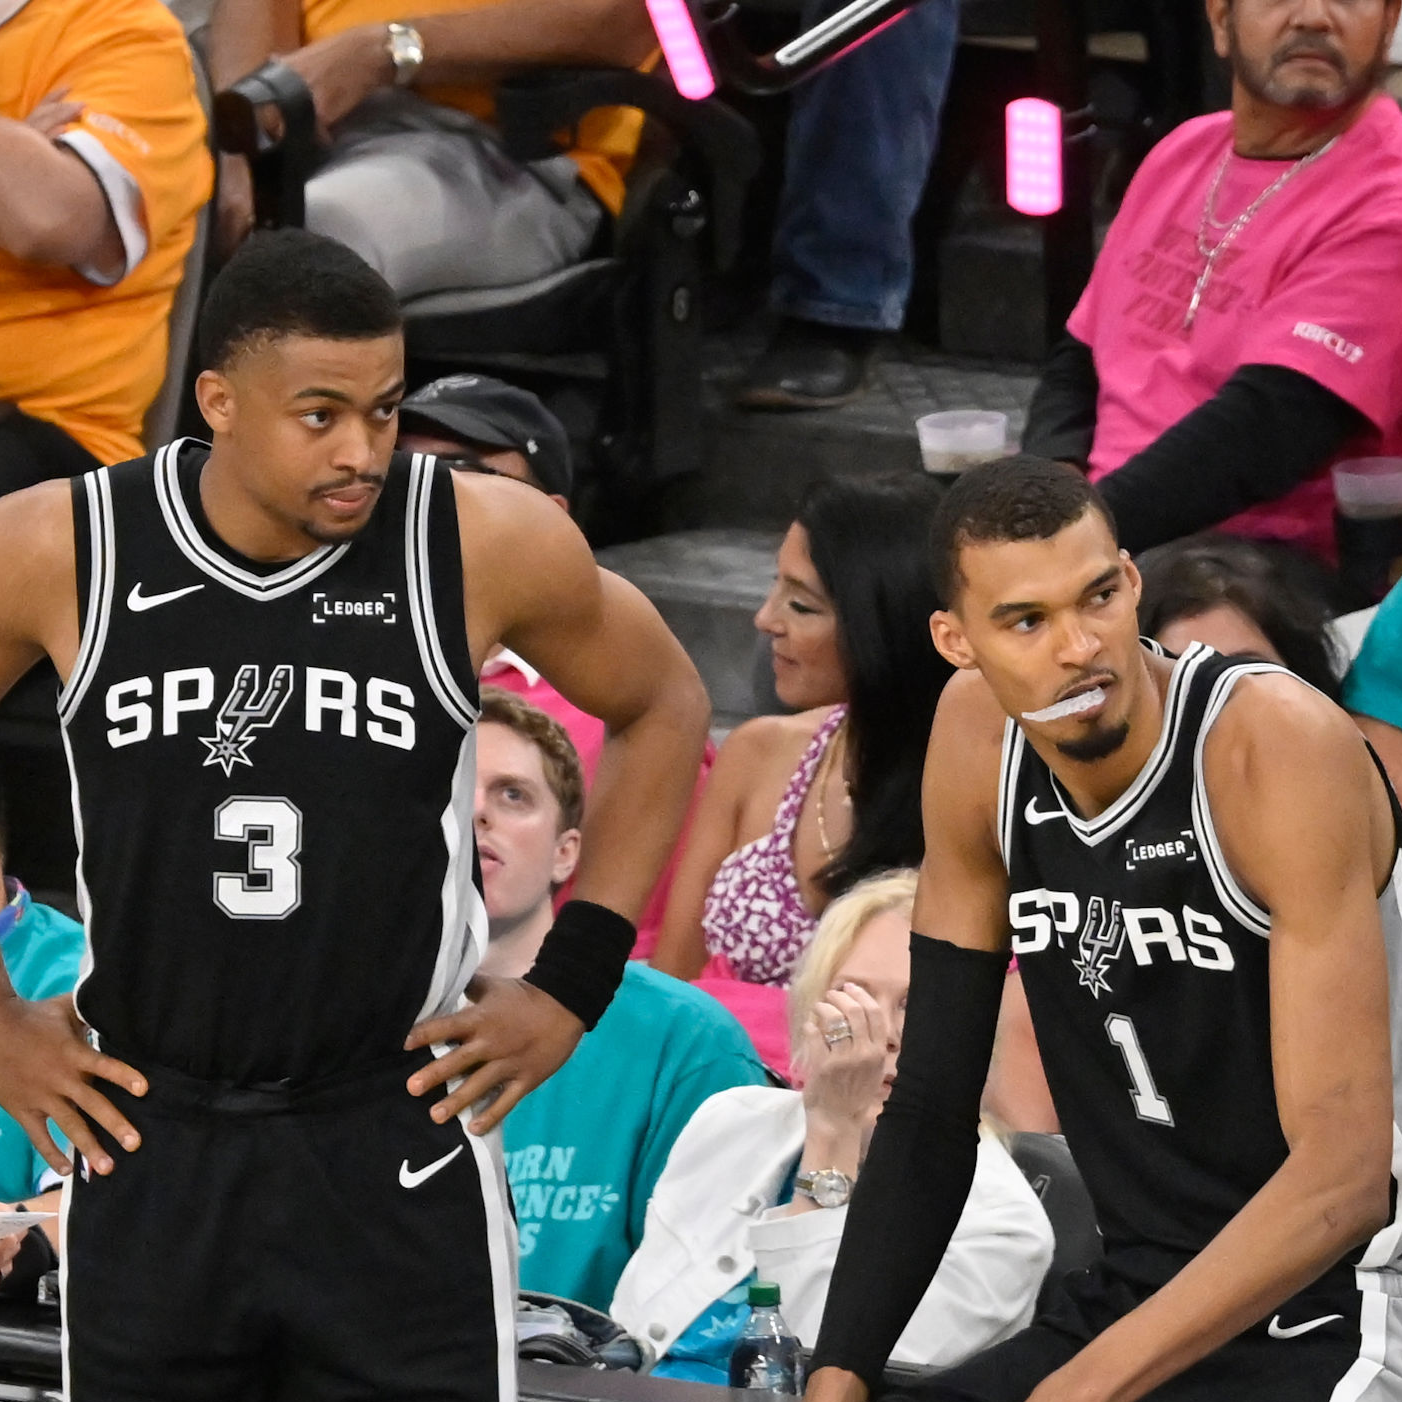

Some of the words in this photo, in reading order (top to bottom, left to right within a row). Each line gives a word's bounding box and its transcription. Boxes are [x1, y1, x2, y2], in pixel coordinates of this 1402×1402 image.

[323, 601, 386, 617] LEDGER
[105, 664, 416, 778] SPURS
[212, 795, 303, 921] 3
[1132, 840, 1186, 861] LEDGER
[1008, 888, 1235, 999] SPURS
[1104, 1012, 1175, 1128] 1
